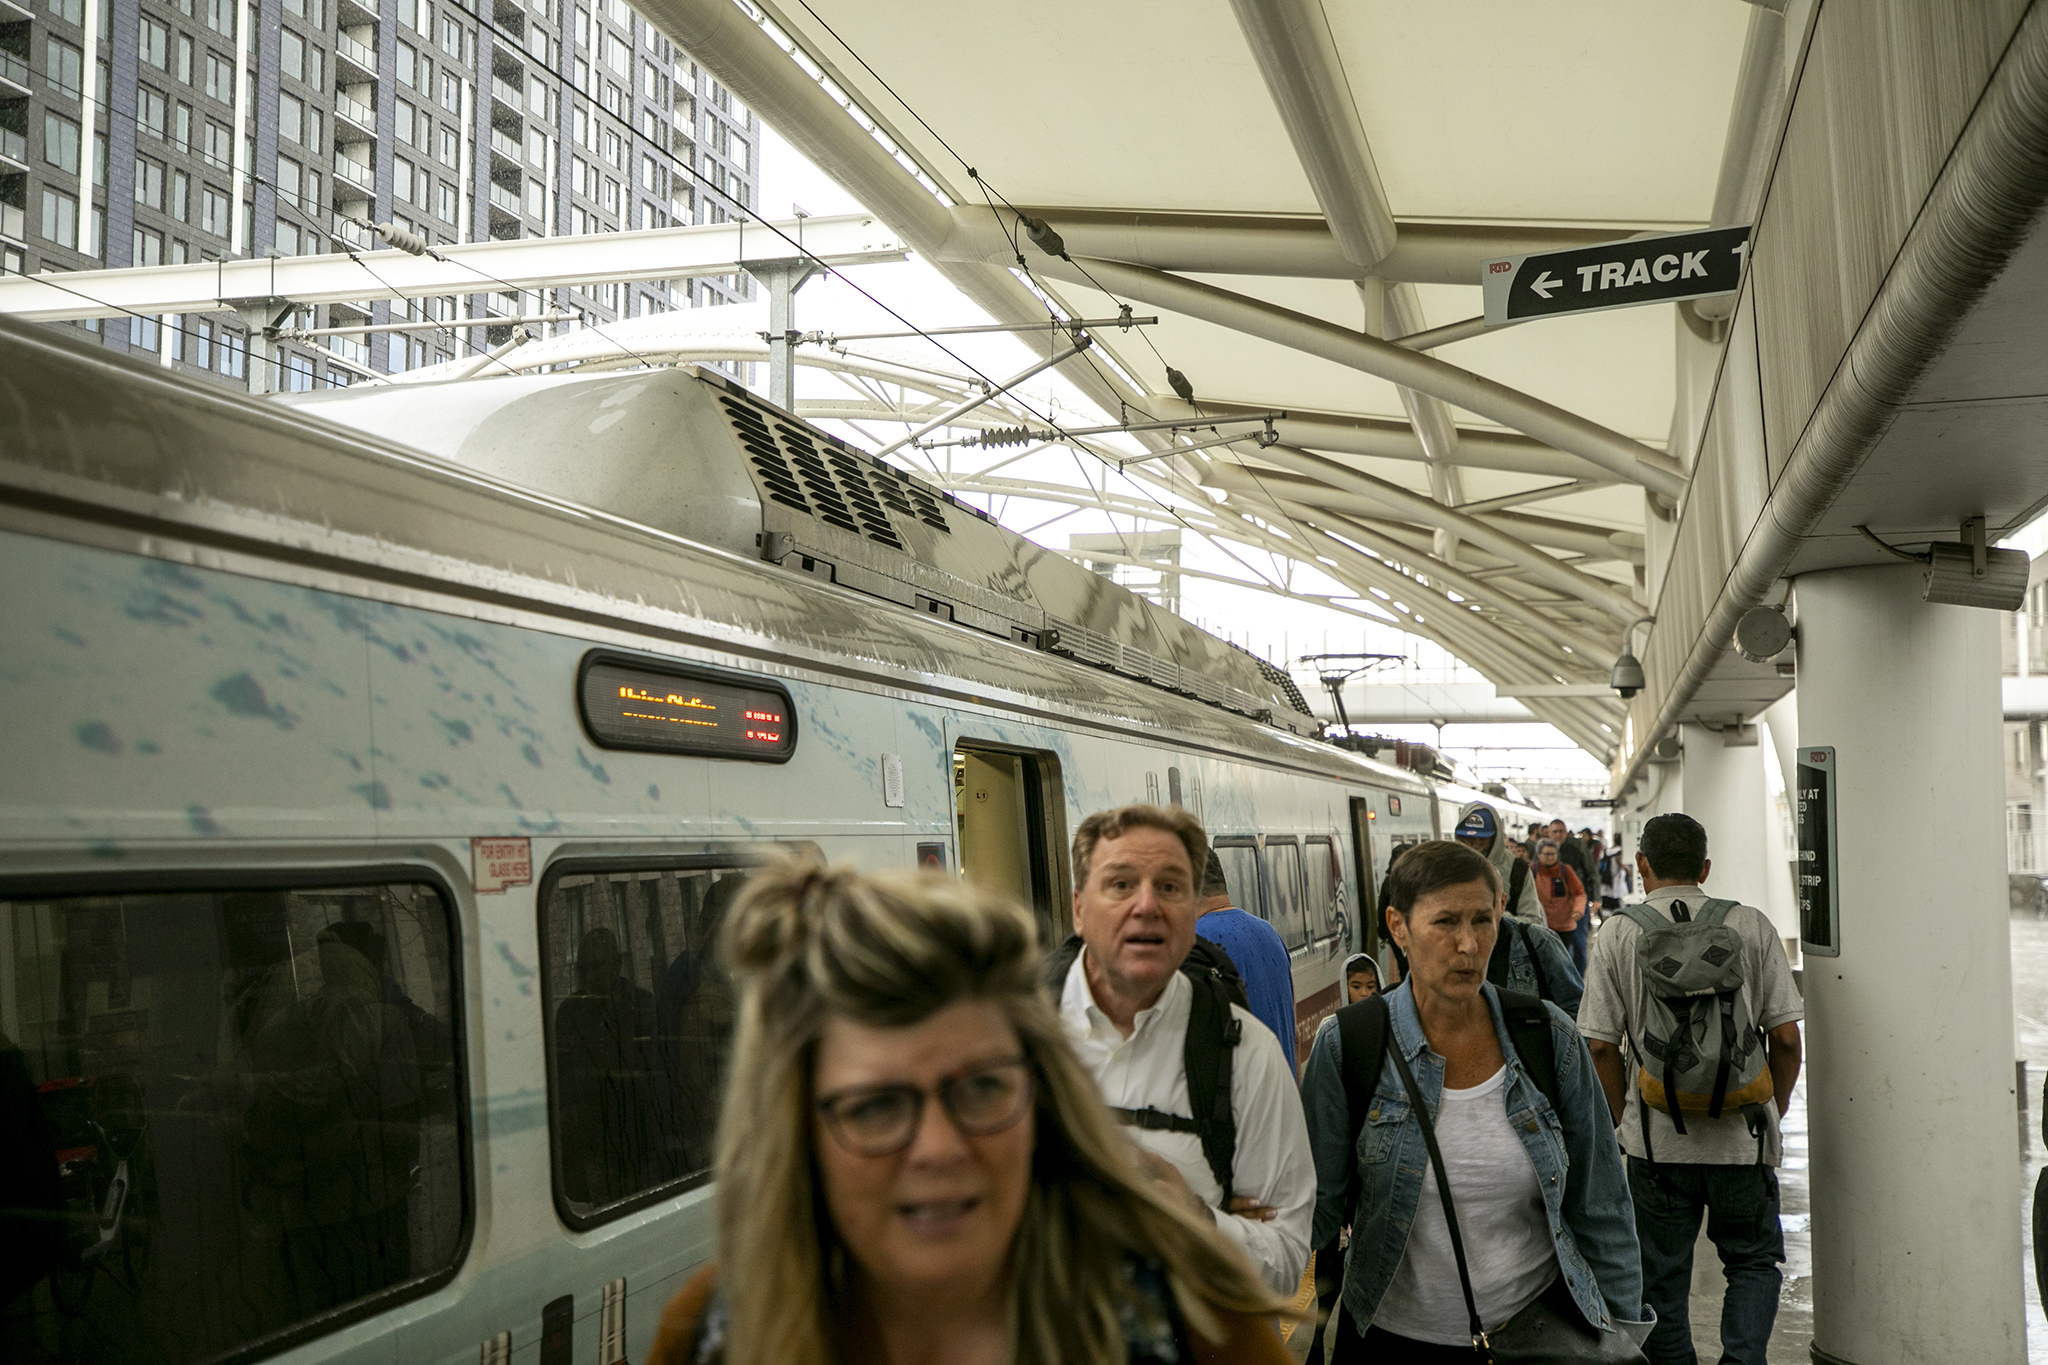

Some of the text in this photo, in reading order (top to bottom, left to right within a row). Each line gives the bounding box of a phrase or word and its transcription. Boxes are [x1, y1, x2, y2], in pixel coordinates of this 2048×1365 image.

[1489, 261, 1512, 274] RTD
[1576, 249, 1710, 293] TRACK
[1809, 751, 1827, 763] RTD
[1808, 788, 1820, 800] AT
